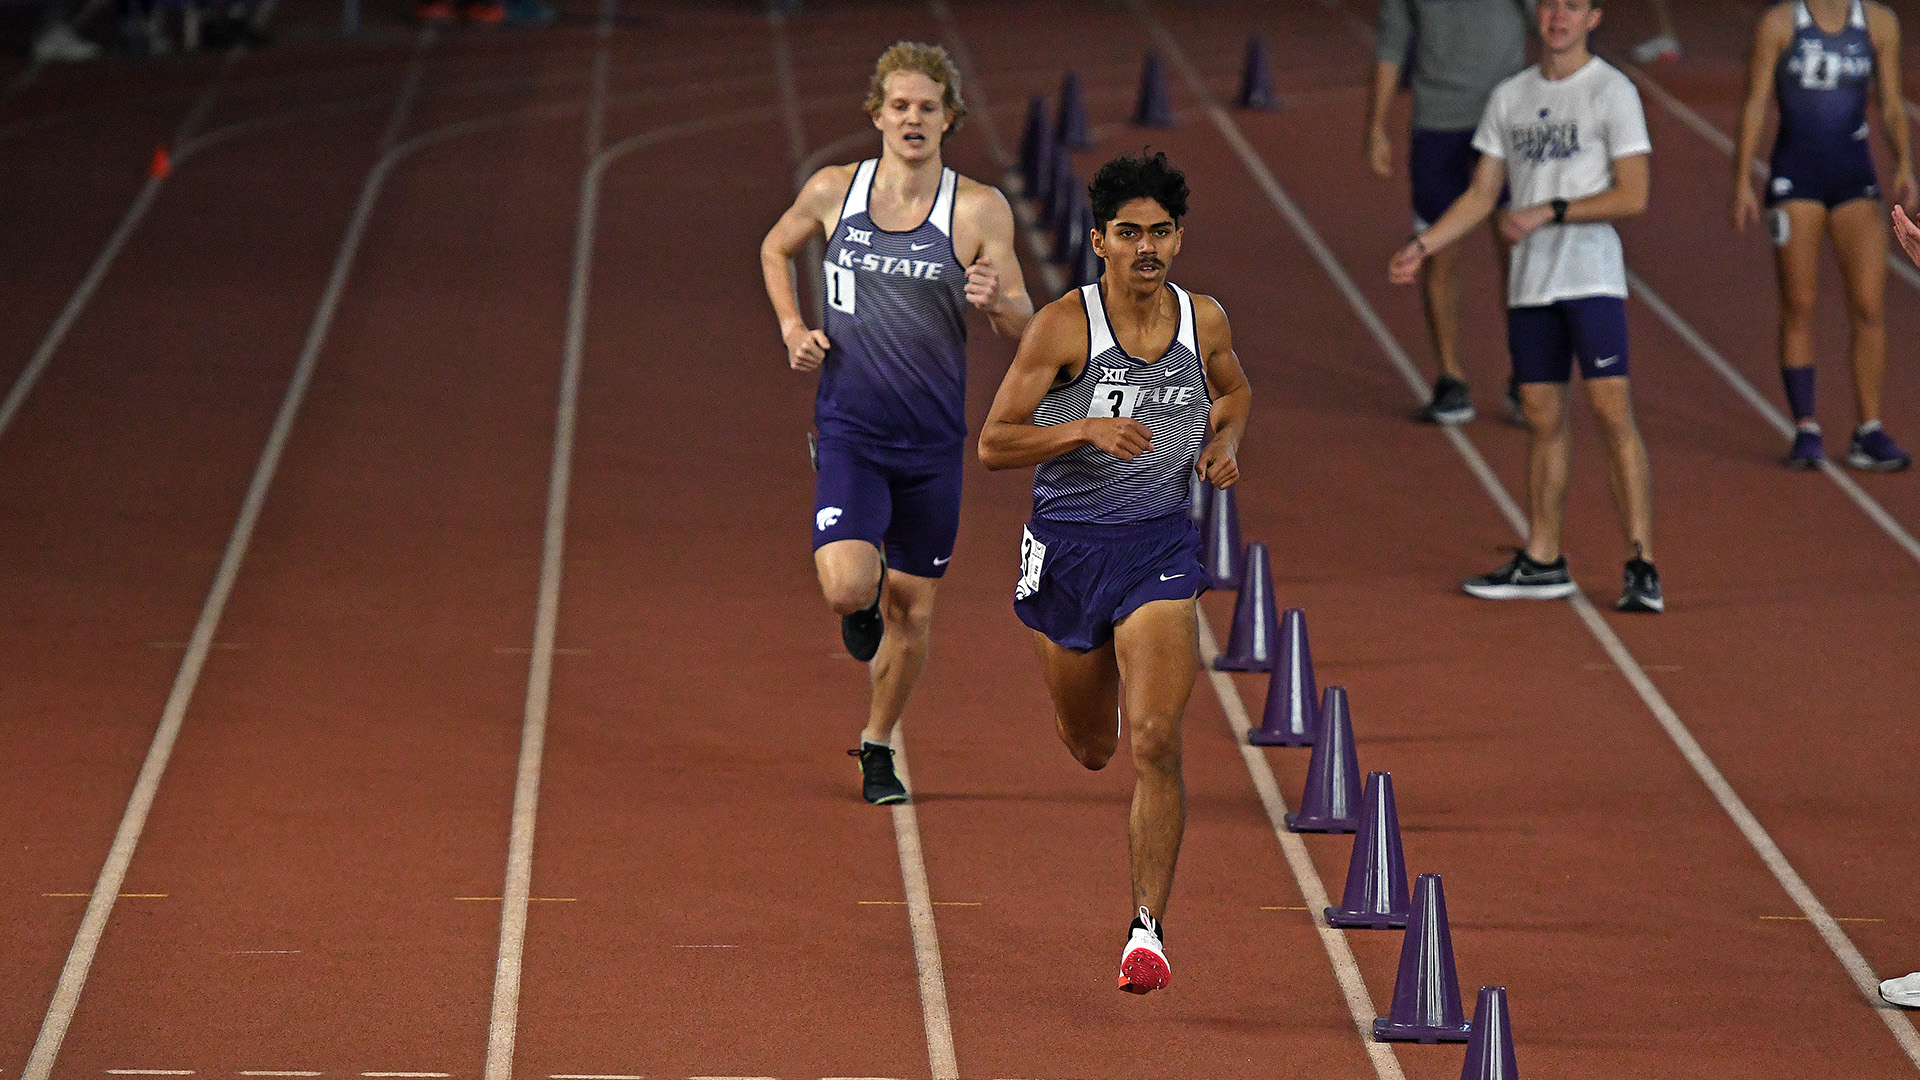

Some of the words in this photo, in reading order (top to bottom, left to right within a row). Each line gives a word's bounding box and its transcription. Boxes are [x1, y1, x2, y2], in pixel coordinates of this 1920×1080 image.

[844, 226, 873, 247] XII
[838, 249, 943, 280] K-STATE
[834, 271, 842, 306] 1
[1098, 366, 1130, 383] XII
[1107, 390, 1124, 418] 3
[1135, 386, 1194, 407] TATE
